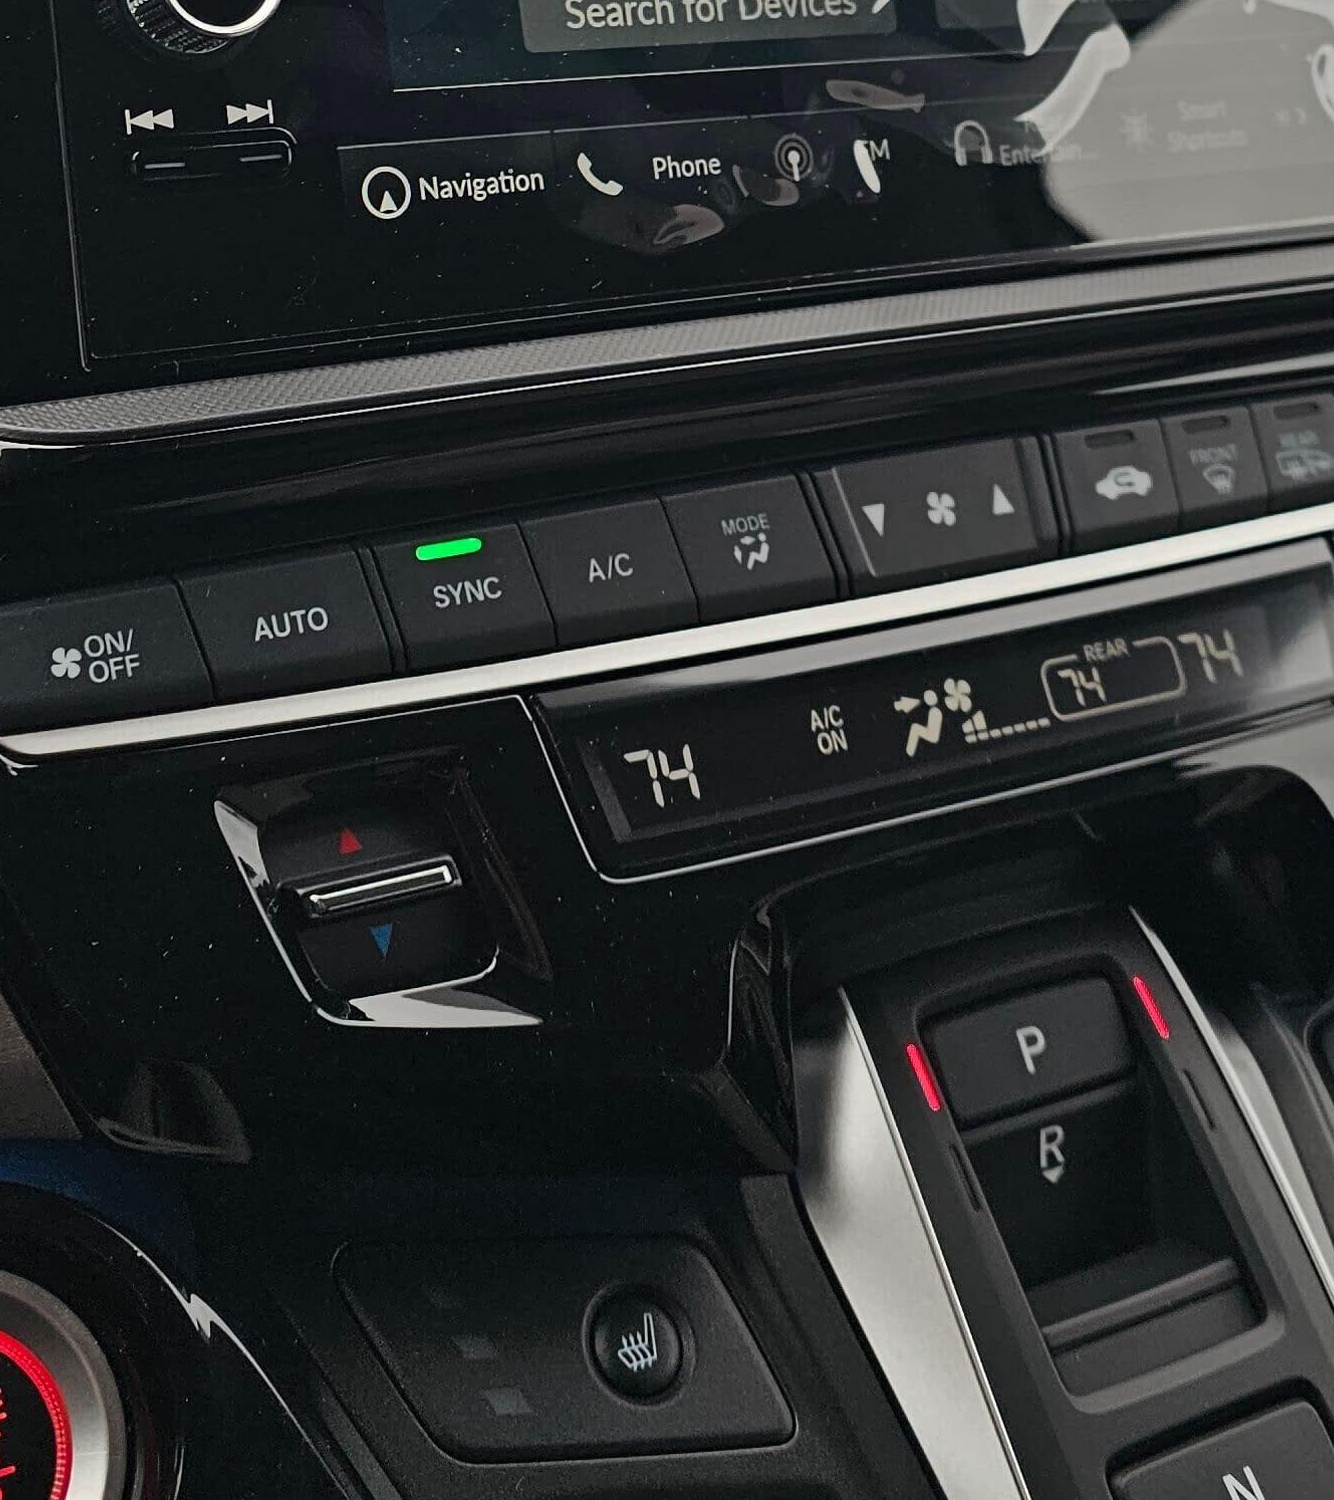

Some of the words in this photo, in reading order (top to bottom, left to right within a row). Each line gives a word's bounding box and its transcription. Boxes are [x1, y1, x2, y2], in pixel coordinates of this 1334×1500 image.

[855, 139, 890, 161] M
[652, 154, 722, 181] Phone
[419, 168, 545, 202] Navigation
[1187, 443, 1238, 466] FRONT
[721, 512, 771, 536] MODE
[588, 553, 634, 583] A/C
[432, 575, 503, 608] SYNC
[254, 606, 330, 642] AUTO
[84, 628, 134, 658] ON/
[1083, 637, 1129, 662] REAR
[1177, 629, 1244, 684] 74
[88, 653, 140, 683] OFF
[1057, 667, 1106, 708] 74
[810, 704, 845, 731] A/C
[817, 729, 848, 756] ON
[624, 744, 701, 808] 74
[1015, 1025, 1047, 1075] P
[1039, 1125, 1067, 1167] R
